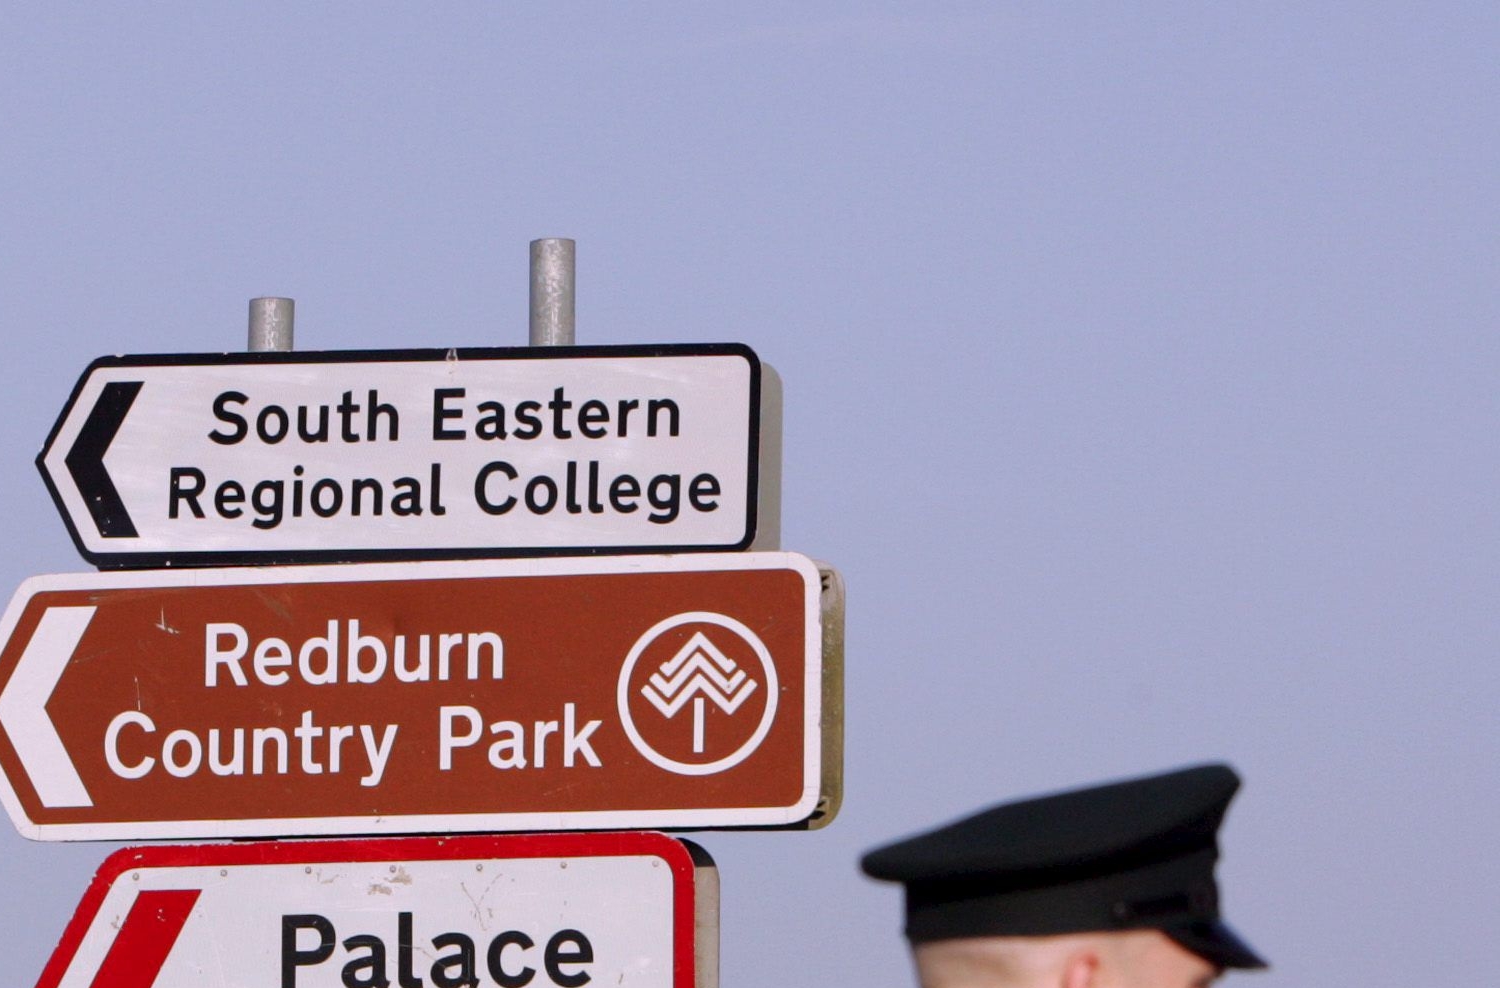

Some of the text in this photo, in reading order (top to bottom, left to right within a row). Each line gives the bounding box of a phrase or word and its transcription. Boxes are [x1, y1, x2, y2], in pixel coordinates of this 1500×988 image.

[207, 386, 681, 446] South Eastern
[168, 460, 721, 530] Regional College
[204, 618, 505, 688] Redburn
[104, 702, 603, 787] Country Park
